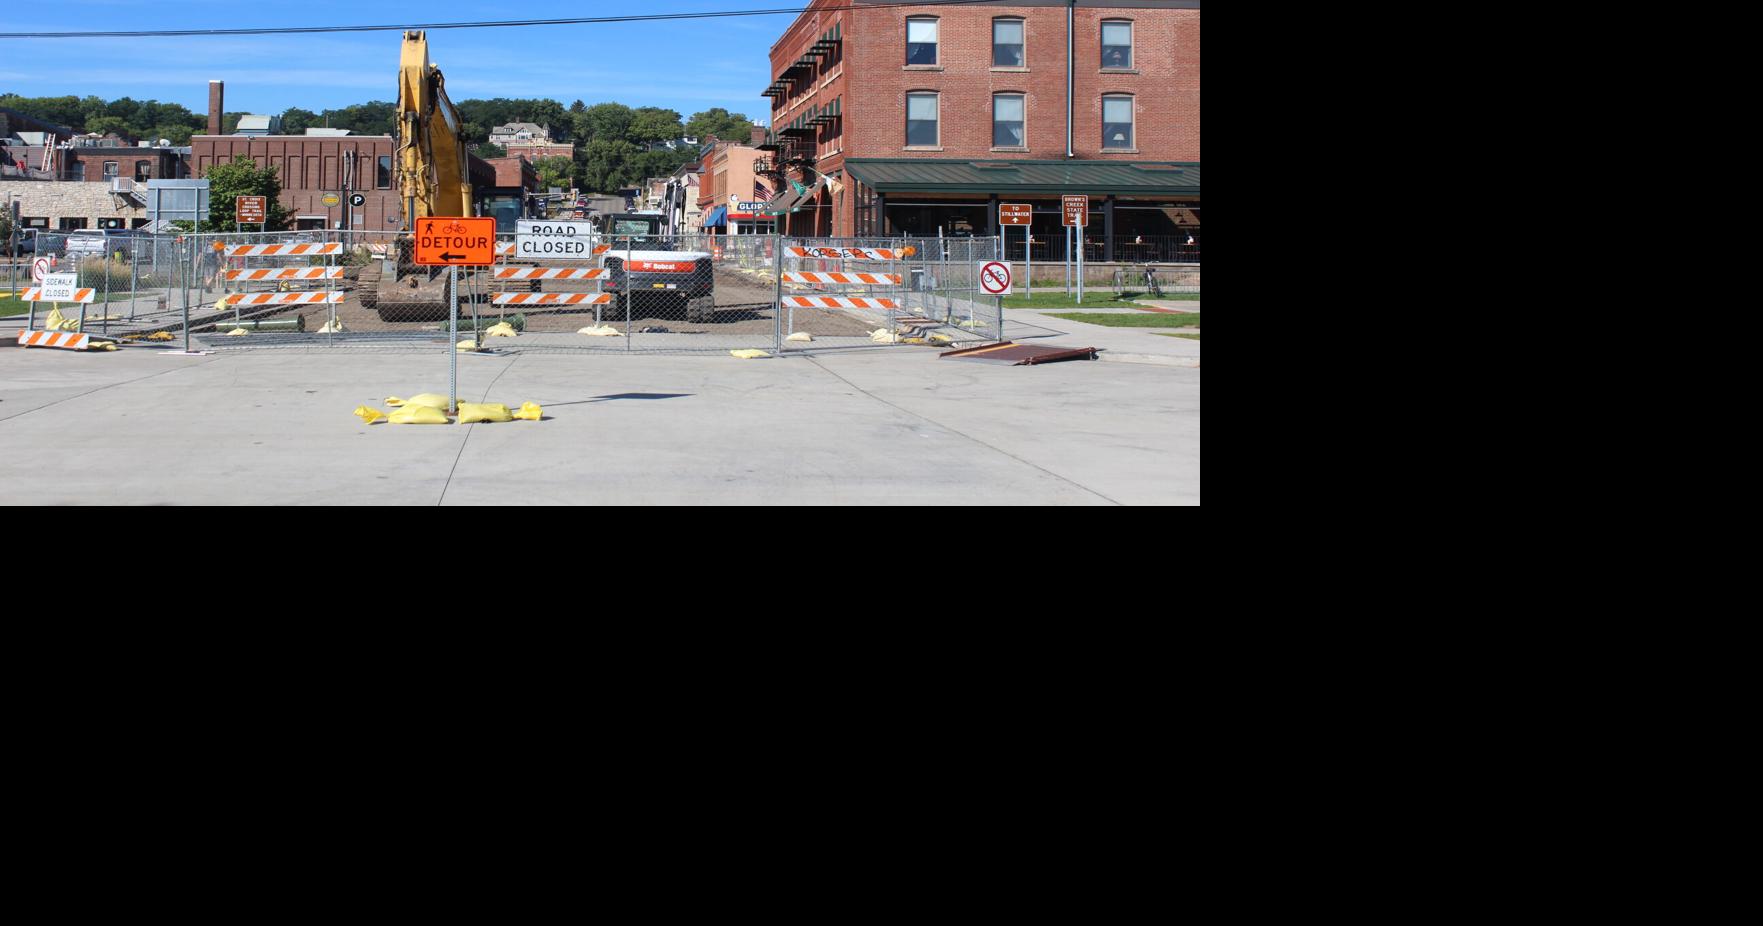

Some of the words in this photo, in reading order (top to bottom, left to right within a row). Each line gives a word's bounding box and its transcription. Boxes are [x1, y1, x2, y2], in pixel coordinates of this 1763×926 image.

[354, 196, 362, 204] P
[532, 225, 577, 238] ROAD
[421, 236, 488, 249] DETOUR
[522, 241, 585, 254] CLOSED
[46, 278, 73, 286] SIDEWALK
[45, 289, 70, 297] CLOSED
